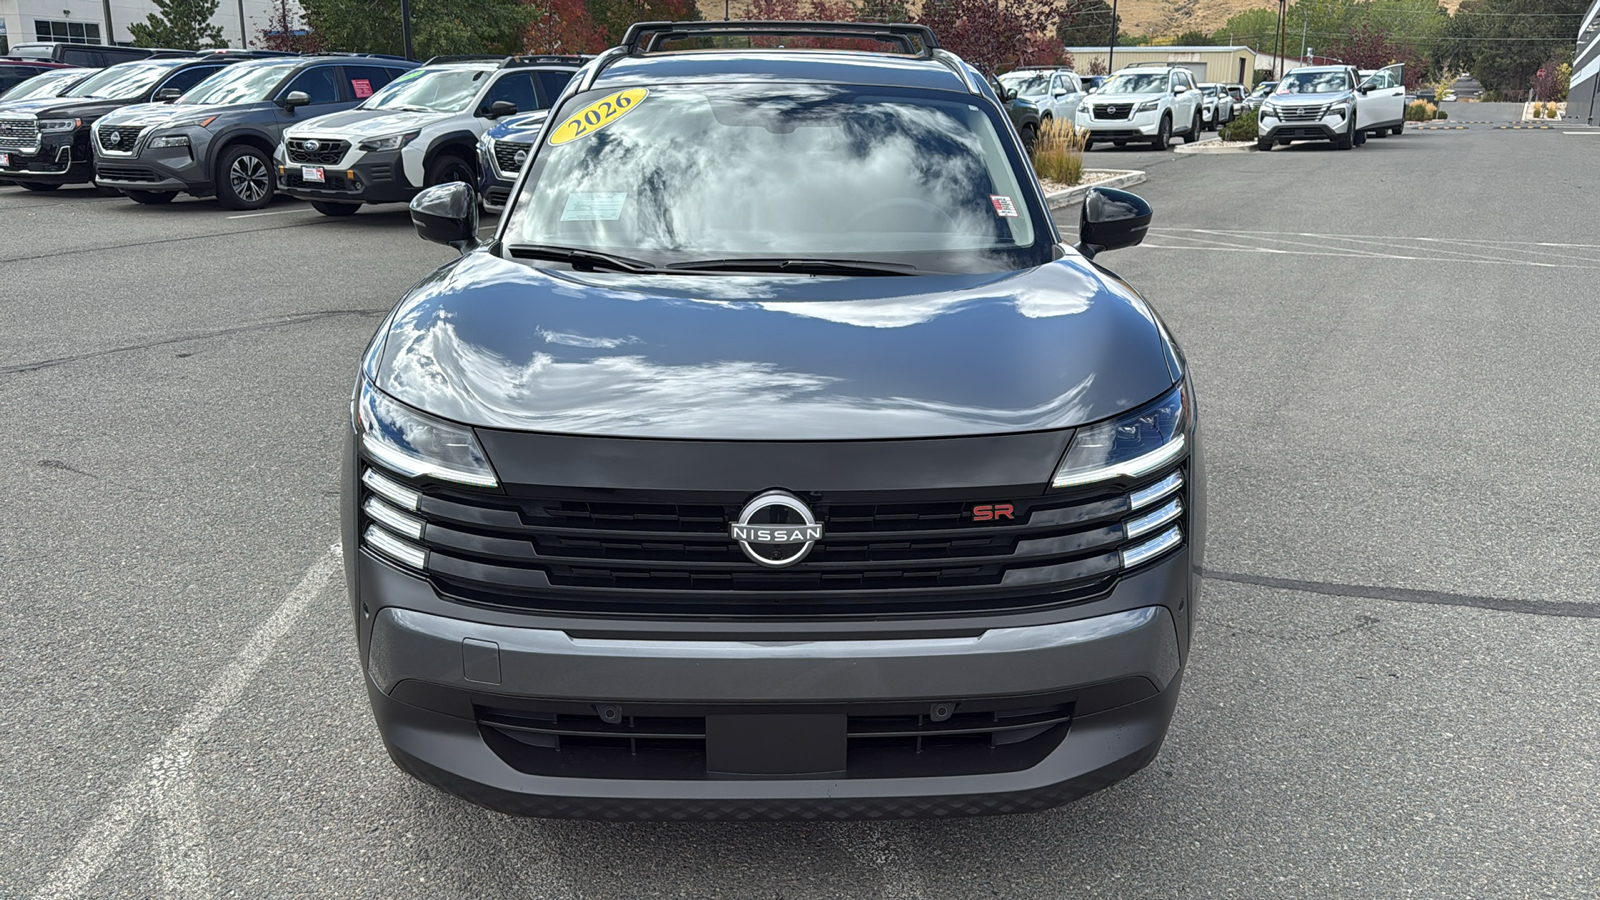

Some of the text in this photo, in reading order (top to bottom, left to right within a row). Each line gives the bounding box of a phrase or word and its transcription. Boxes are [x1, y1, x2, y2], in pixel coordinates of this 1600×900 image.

[567, 92, 632, 137] 2026
[973, 504, 1014, 521] SR
[733, 527, 820, 541] NISSAN
